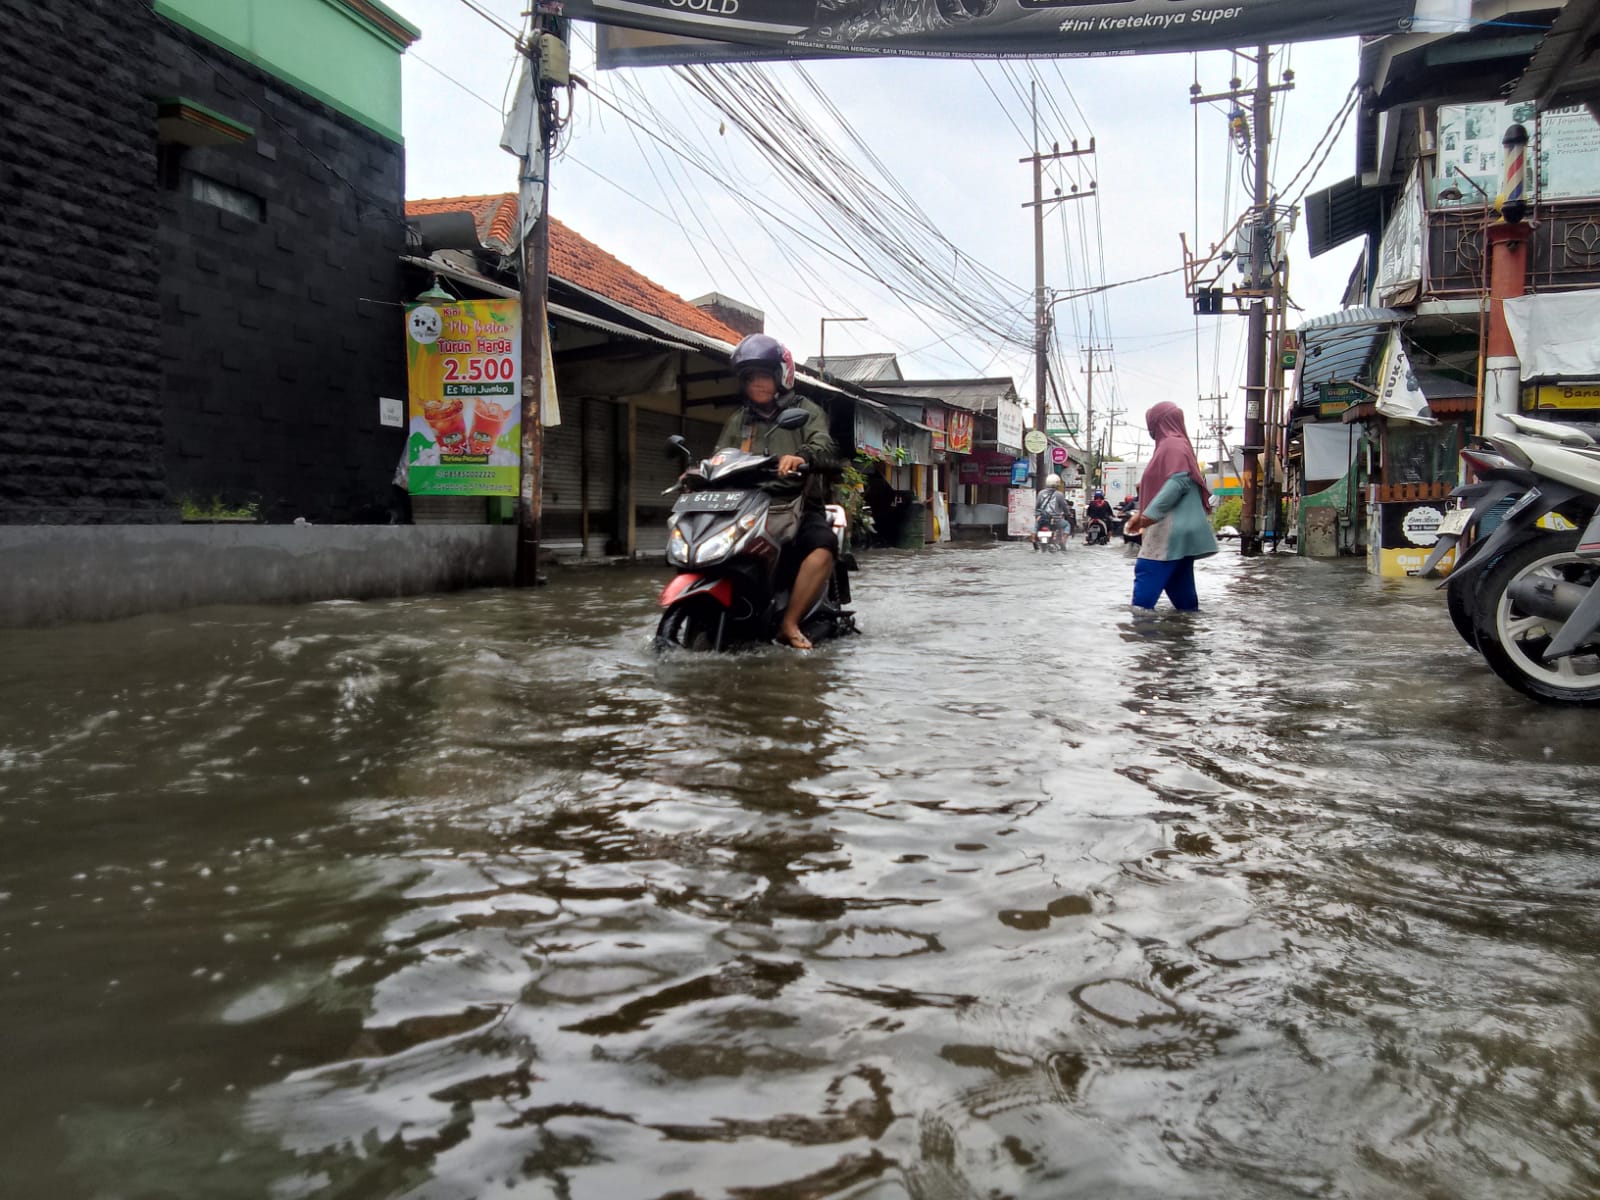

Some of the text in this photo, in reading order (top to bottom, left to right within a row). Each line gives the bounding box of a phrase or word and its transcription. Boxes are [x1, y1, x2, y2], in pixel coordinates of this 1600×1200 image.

[1060, 6, 1243, 32] #Ini Kreteknya Super
[826, 41, 850, 52] KARENA
[883, 47, 897, 56] SAYA
[899, 48, 925, 57] TERKENA
[443, 308, 461, 317] Kini
[438, 338, 513, 356] Turun Harga
[444, 358, 514, 381] 2.500
[1384, 353, 1405, 398] BUKA
[446, 383, 509, 395] Es Teh Jumbo
[694, 494, 721, 502] 6412
